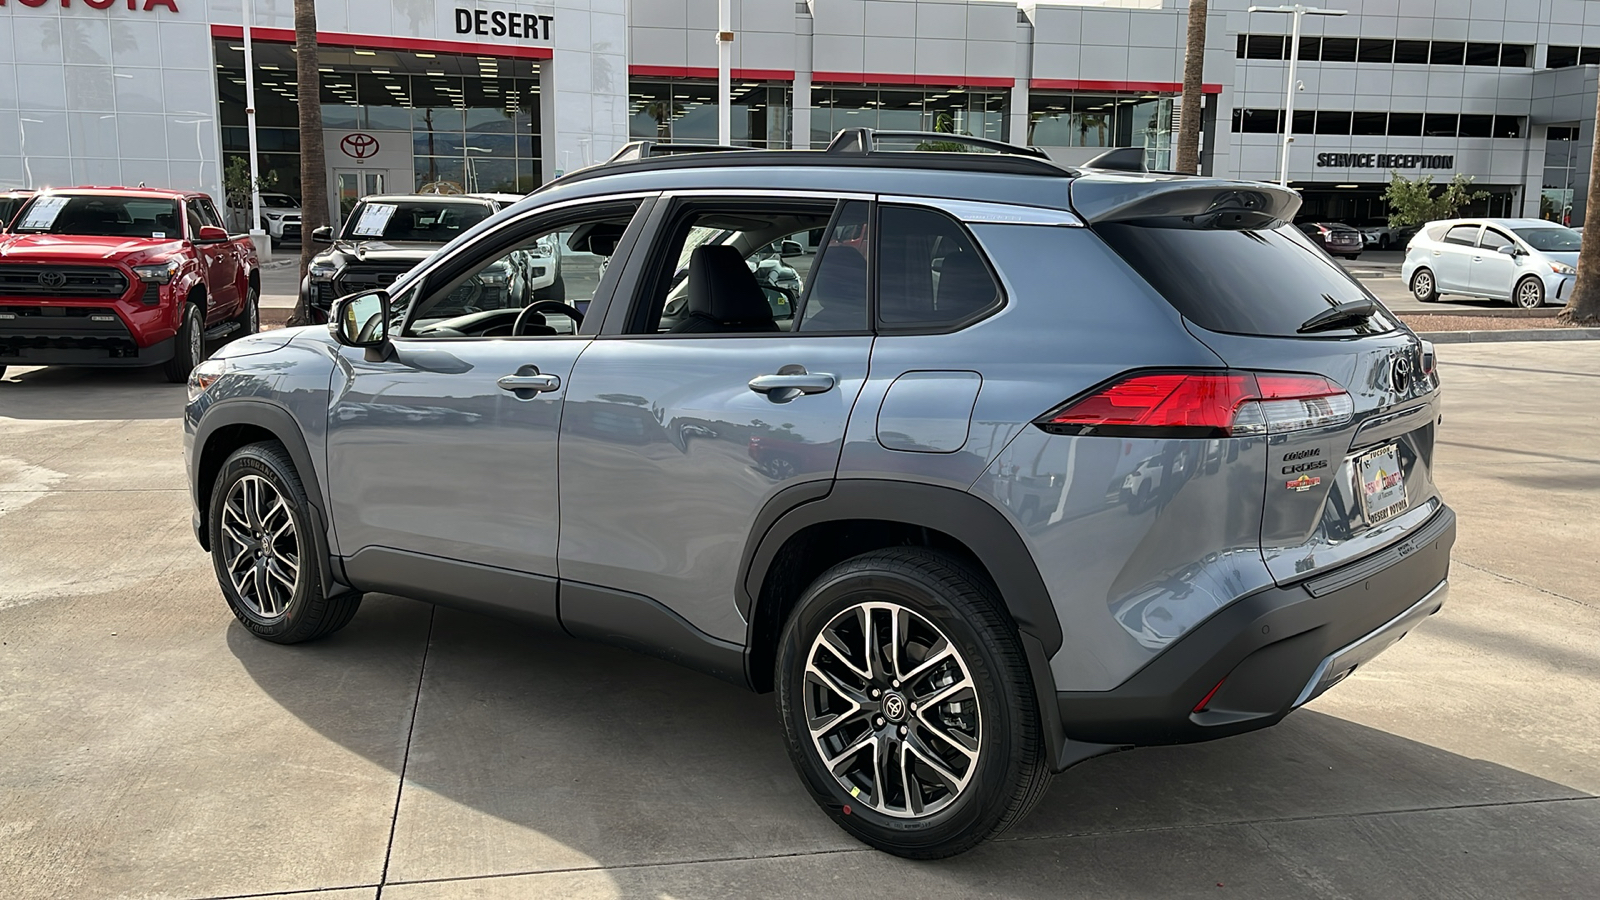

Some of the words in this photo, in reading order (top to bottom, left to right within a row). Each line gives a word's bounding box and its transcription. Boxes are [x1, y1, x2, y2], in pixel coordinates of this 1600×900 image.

[455, 8, 554, 40] DESERT
[1317, 153, 1376, 168] SERVICE
[1376, 154, 1454, 169] RECEPTION
[1282, 447, 1321, 461] COROLLA
[1370, 446, 1390, 459] TUCSON
[1281, 459, 1328, 475] CROSS
[1370, 508, 1389, 525] DESERT
